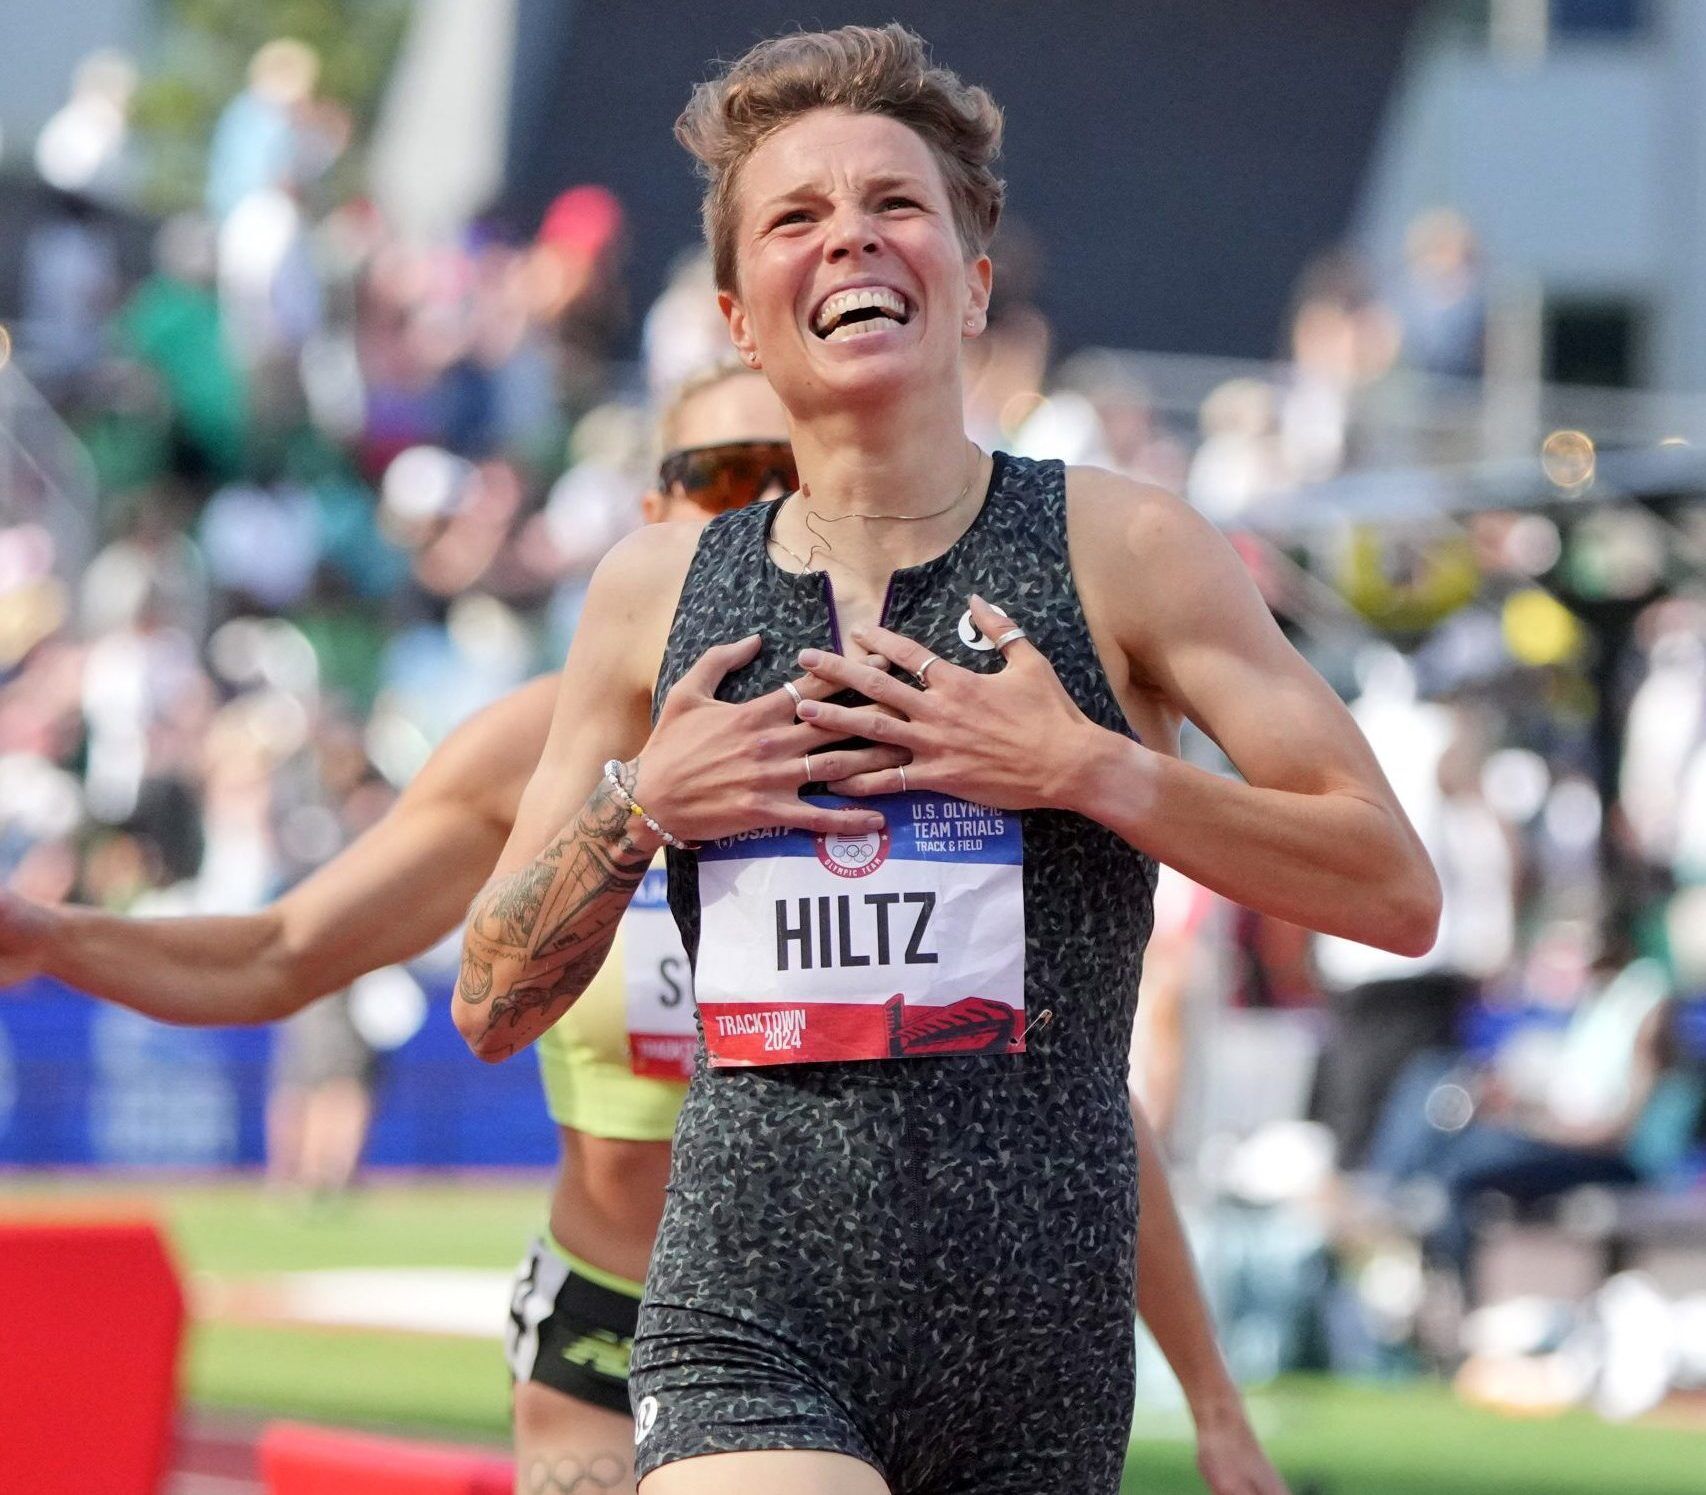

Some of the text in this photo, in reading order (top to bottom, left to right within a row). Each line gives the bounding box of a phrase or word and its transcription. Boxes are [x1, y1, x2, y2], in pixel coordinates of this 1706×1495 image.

[912, 803, 939, 820] U.S.
[913, 819, 1005, 839] TEAM TRIALS
[914, 839, 983, 852] TRACK & FIELD
[824, 857, 882, 877] OLYMPIC TEAM
[775, 891, 939, 971] HILTZ
[715, 1008, 807, 1037] TRACKTOWN
[763, 1029, 803, 1052] 2024
